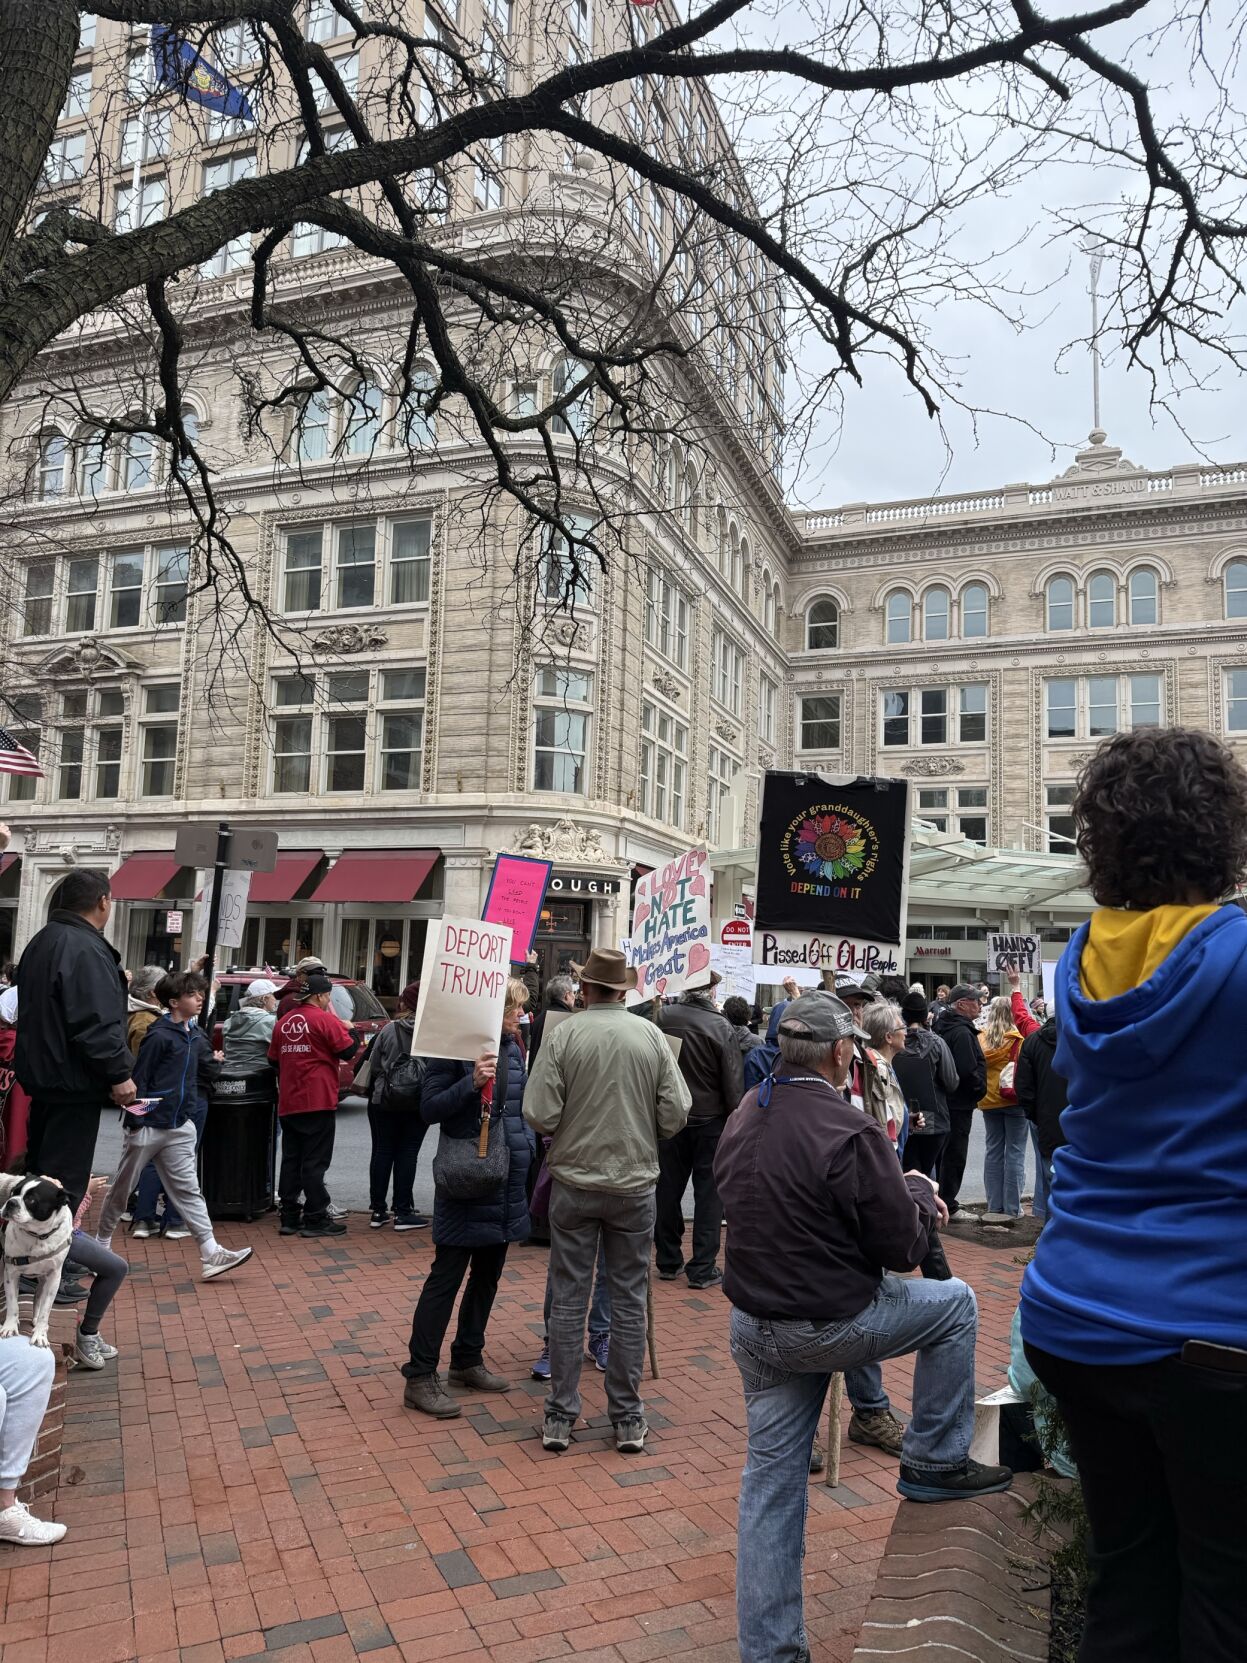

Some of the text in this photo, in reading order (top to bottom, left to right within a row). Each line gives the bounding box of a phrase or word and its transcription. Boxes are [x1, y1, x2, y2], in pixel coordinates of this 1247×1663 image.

[1055, 479, 1145, 501] WATT & SHAND
[780, 803, 880, 882] Vote like your granddaughter's rights
[551, 879, 612, 894] OUGH
[651, 850, 700, 896] LOVE
[790, 881, 862, 899] DEPEND ON IT
[204, 888, 242, 921] HNDS
[651, 877, 693, 918] NOT
[644, 898, 697, 943] HATE
[445, 925, 508, 964] DEPORT
[632, 941, 661, 965] Makes
[660, 925, 708, 956] America
[763, 933, 897, 973] Pissed Off Old People
[914, 946, 951, 957] Marriott
[992, 936, 1036, 953] HANDS
[440, 962, 505, 998] TRUMP
[645, 947, 687, 985] Great
[281, 1021, 310, 1034] CASA
